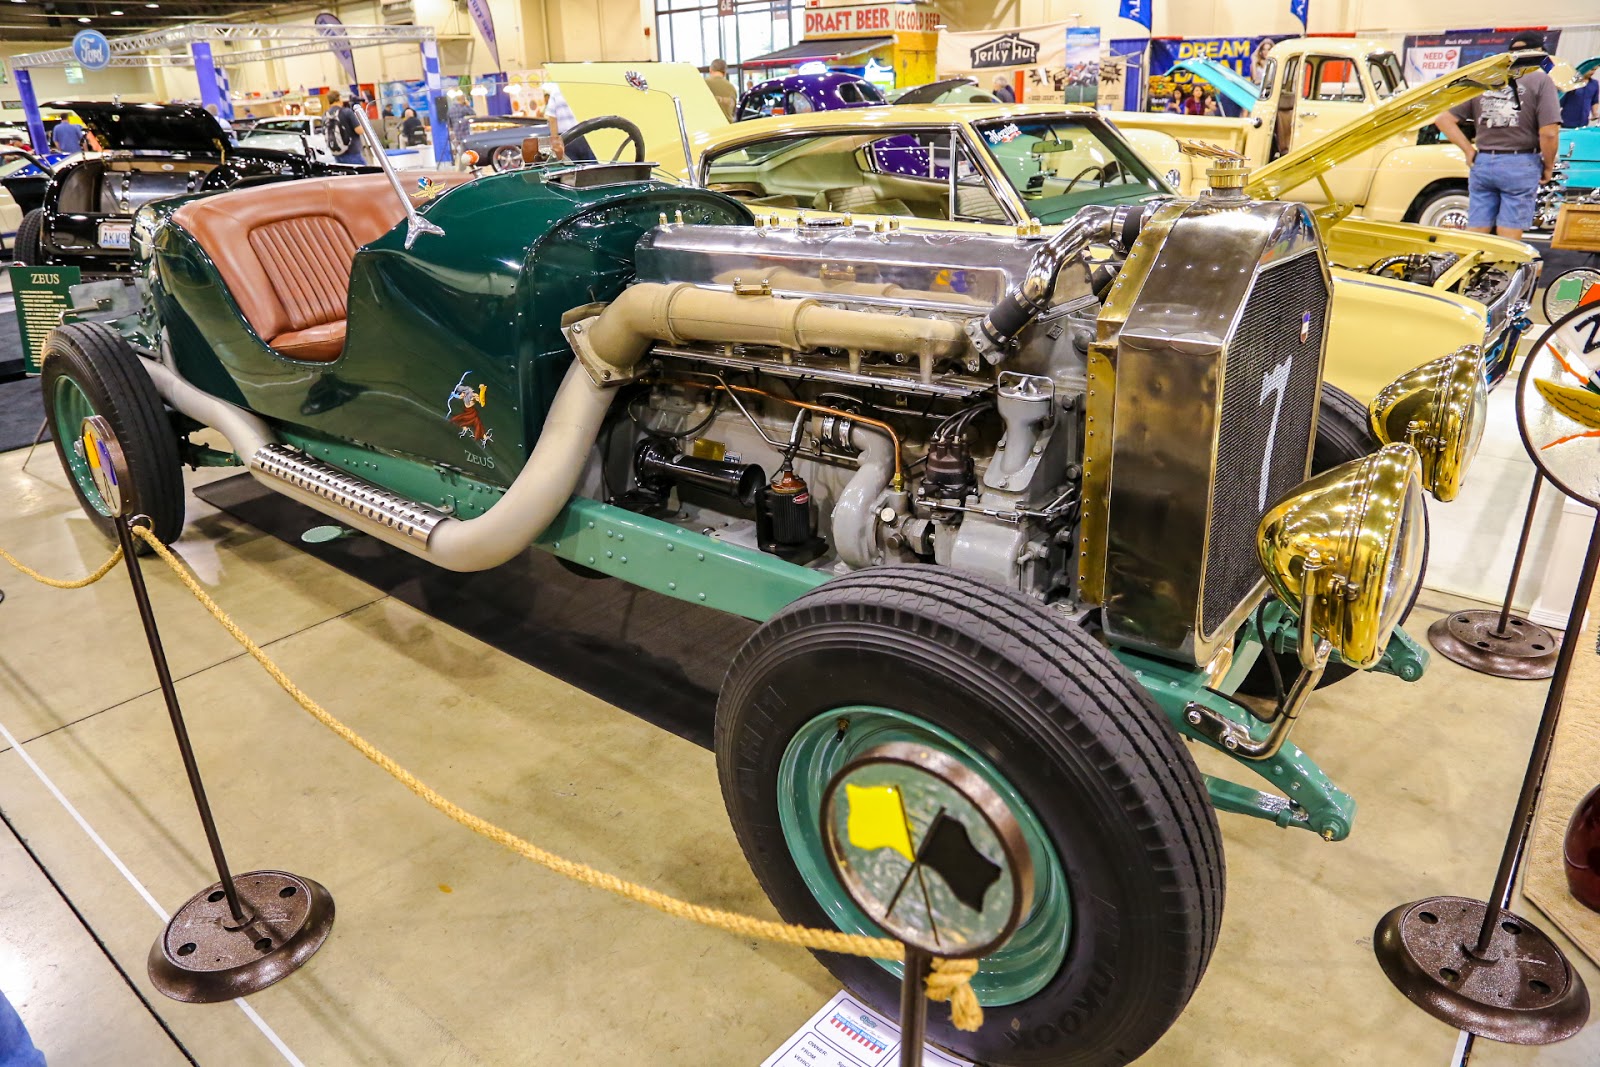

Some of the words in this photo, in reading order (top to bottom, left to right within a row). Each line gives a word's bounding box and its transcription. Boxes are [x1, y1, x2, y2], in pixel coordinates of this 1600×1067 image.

[805, 11, 852, 32] DRAFT
[856, 8, 889, 30] BEER
[895, 10, 905, 29] ICE
[906, 11, 924, 30] COLD
[925, 12, 940, 31] BEER
[80, 37, 104, 63] Ford
[974, 43, 1009, 65] Jerky
[1178, 41, 1250, 59] DREAM
[1423, 52, 1443, 60] NEED
[31, 273, 60, 285] ZEUS
[464, 449, 495, 469] ZEUS
